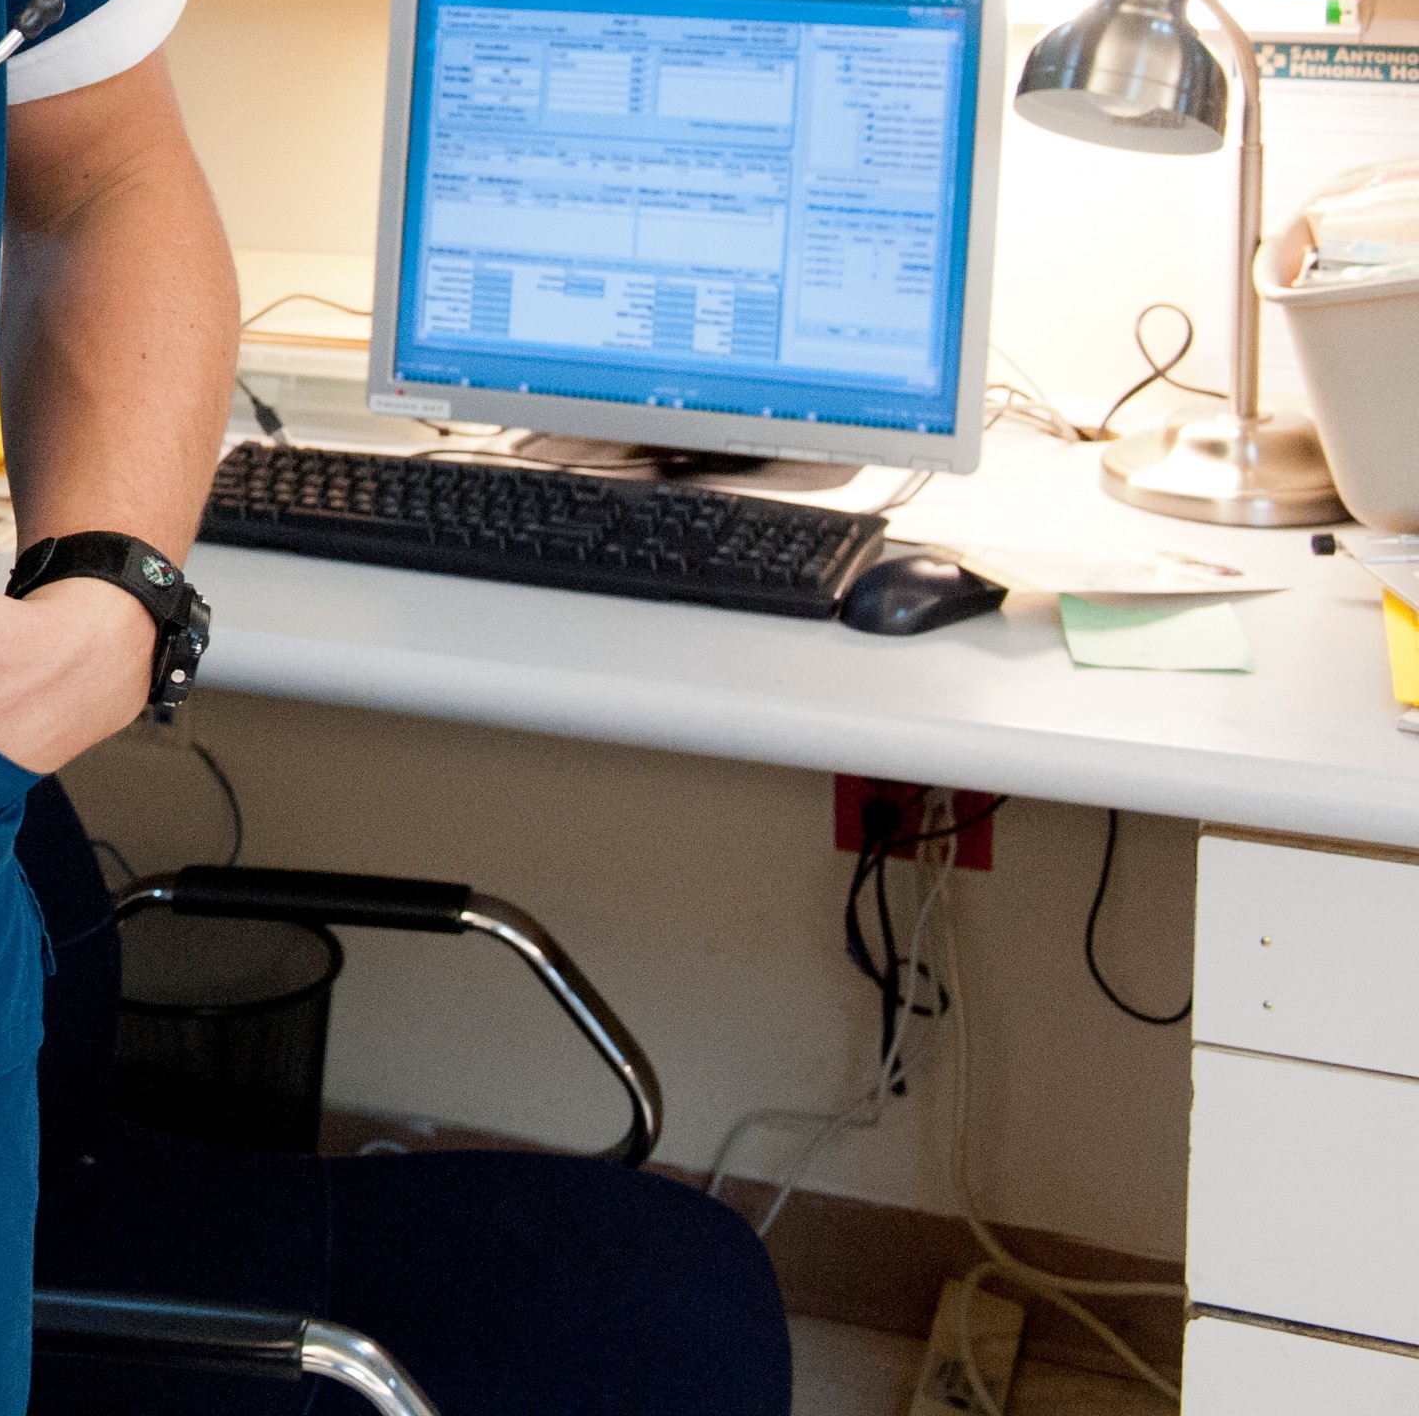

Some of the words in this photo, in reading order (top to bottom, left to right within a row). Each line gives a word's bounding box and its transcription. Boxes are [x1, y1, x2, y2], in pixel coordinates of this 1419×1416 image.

[1290, 46, 1328, 62] SAN
[1334, 47, 1419, 65] ANTONIO
[1289, 61, 1384, 81] MEMORIAL
